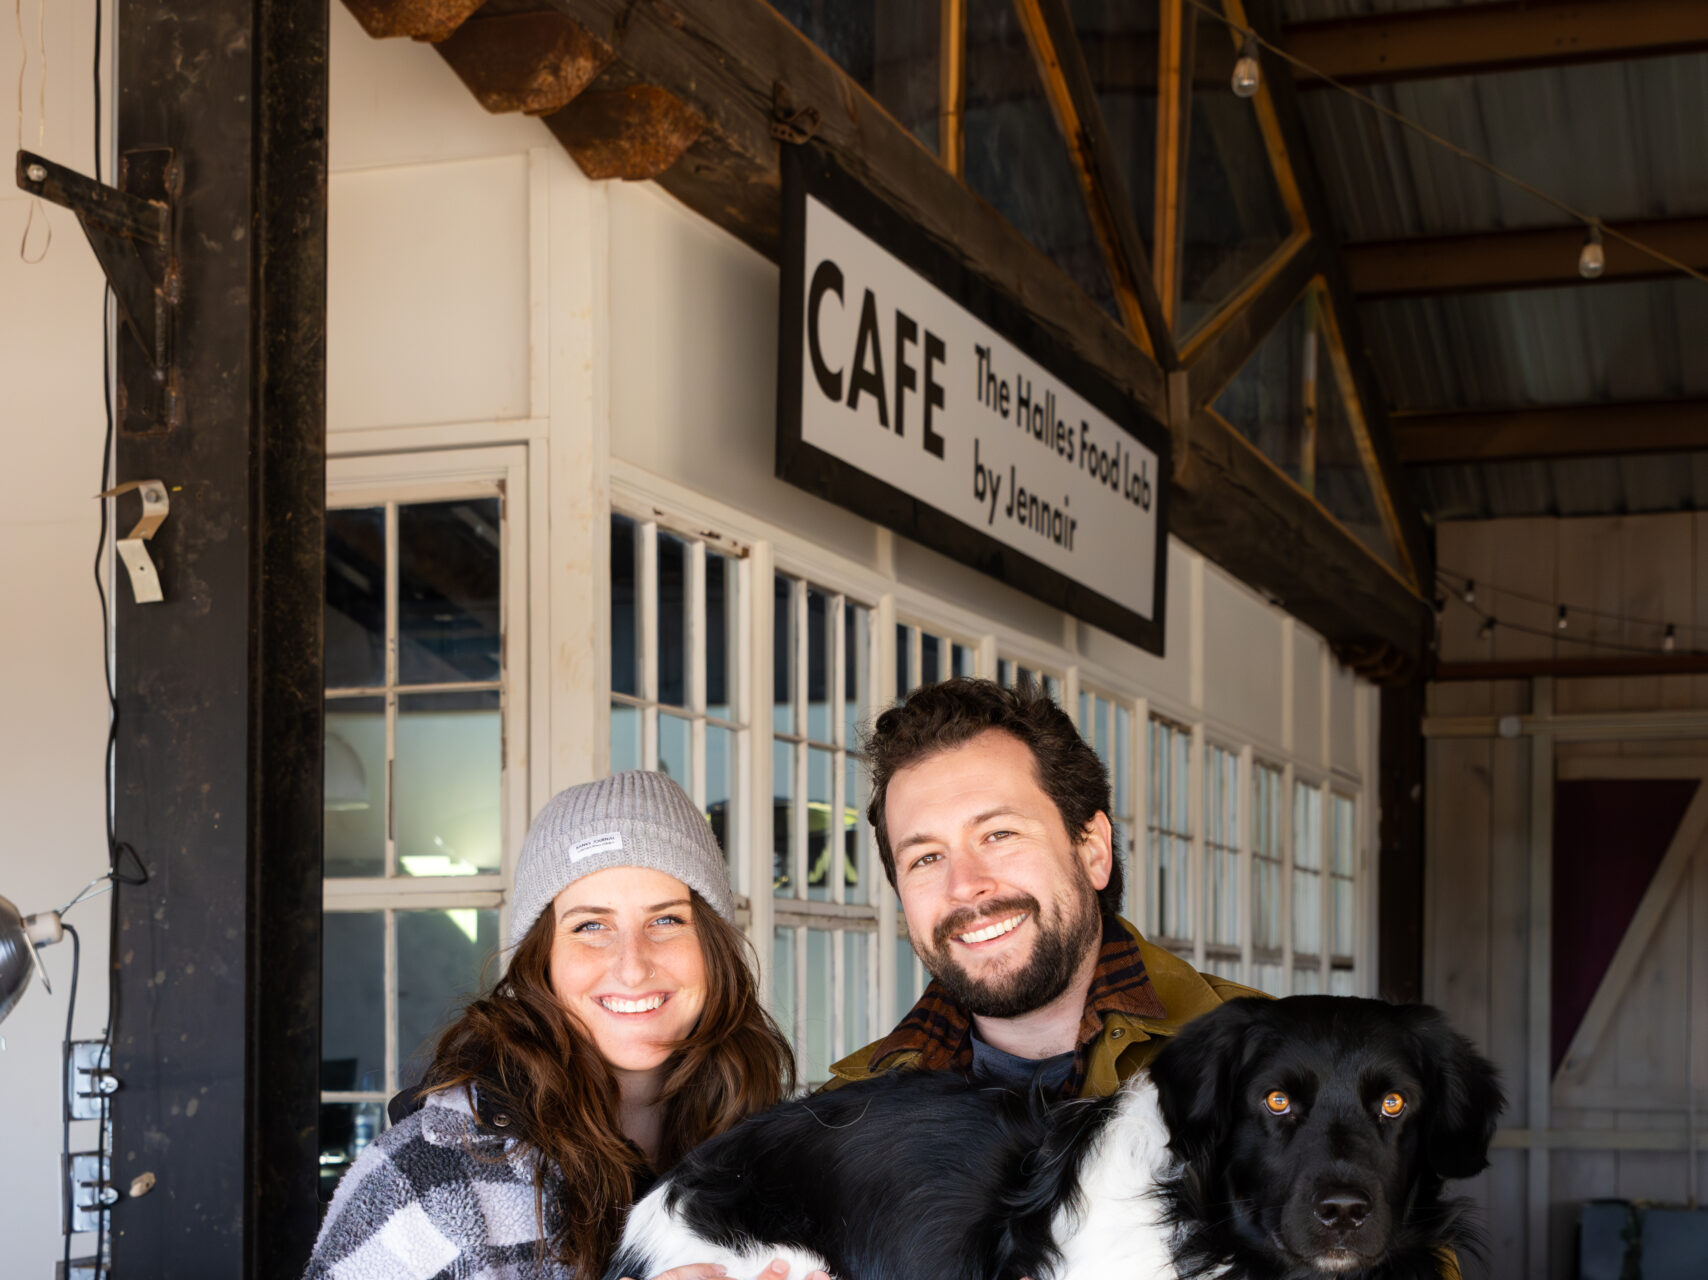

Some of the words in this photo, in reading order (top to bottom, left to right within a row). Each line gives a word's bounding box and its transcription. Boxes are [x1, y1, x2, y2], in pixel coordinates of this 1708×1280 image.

[807, 259, 946, 461] CAFE
[974, 343, 1010, 419] The
[1017, 373, 1075, 463] Halles
[1079, 420, 1121, 492] Food
[1124, 452, 1151, 513] Lab
[974, 437, 1001, 526] by
[1006, 465, 1077, 551] Jennair
